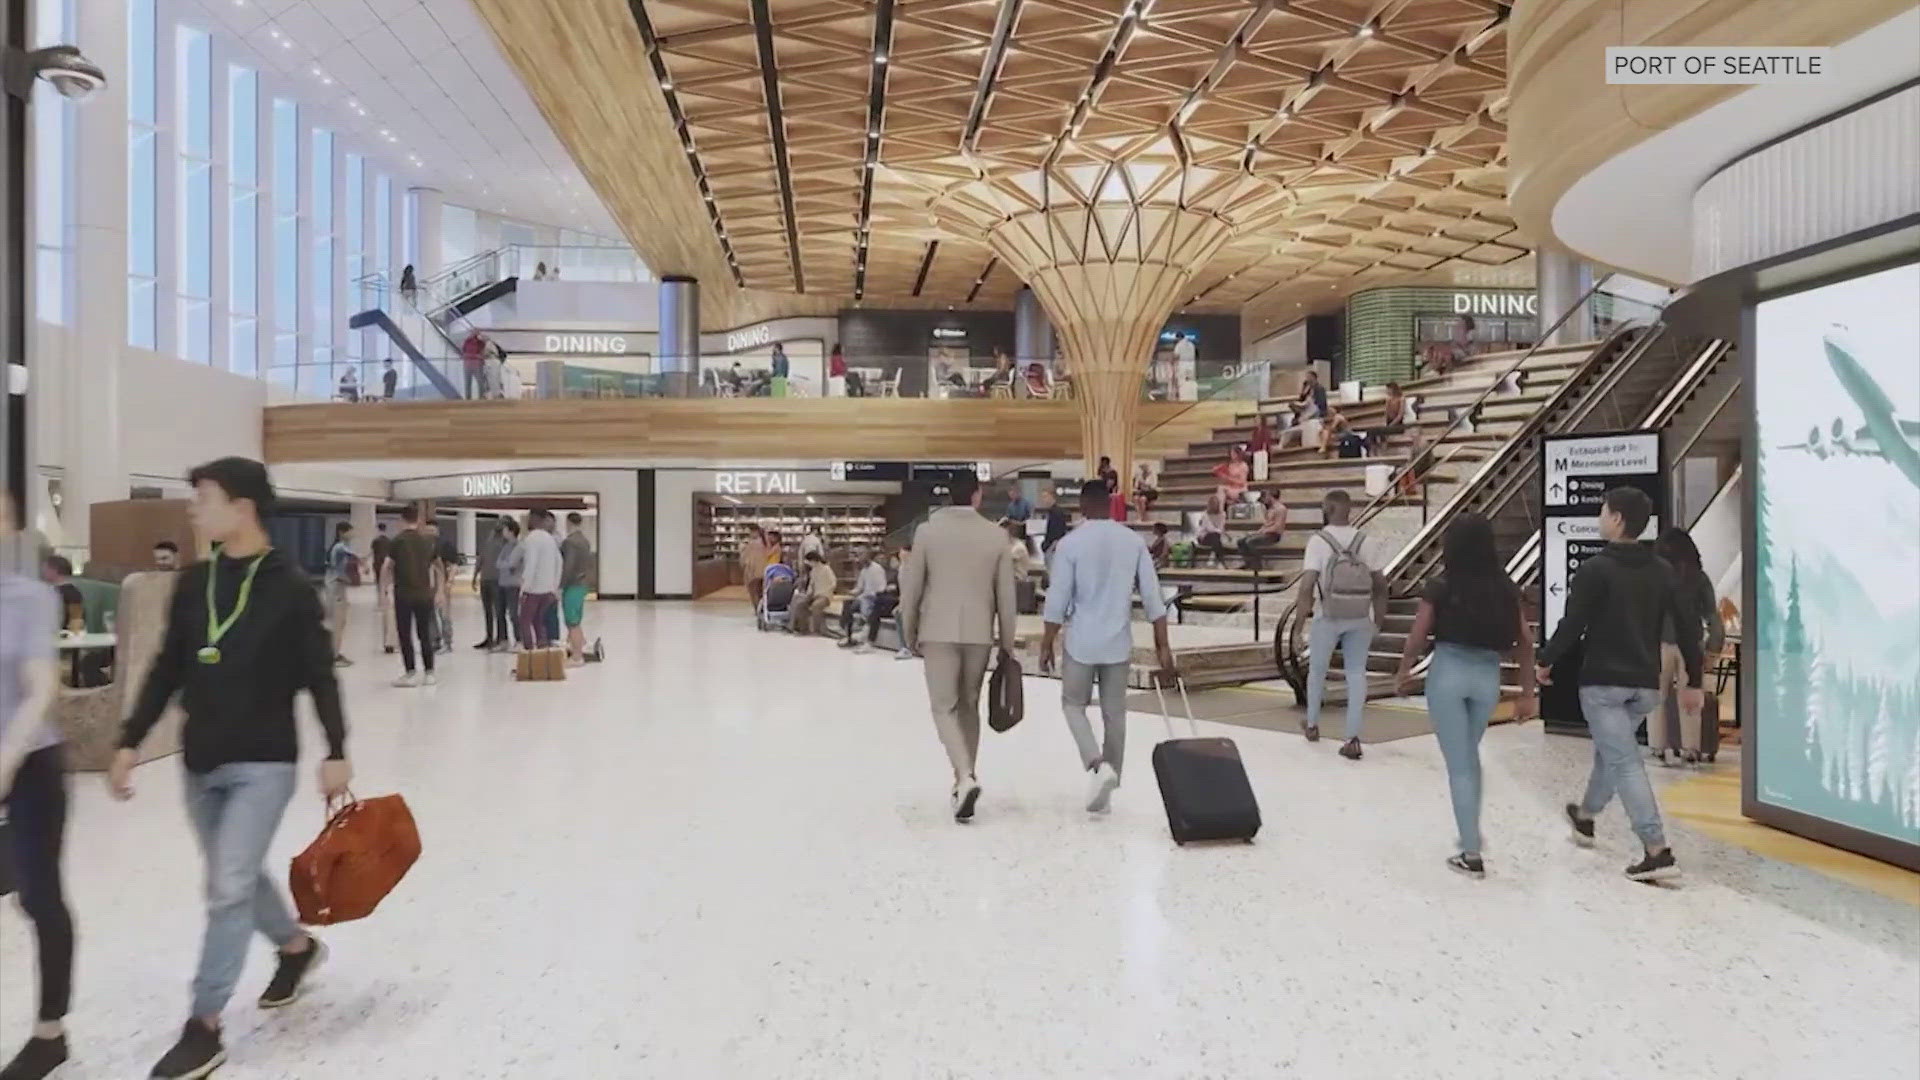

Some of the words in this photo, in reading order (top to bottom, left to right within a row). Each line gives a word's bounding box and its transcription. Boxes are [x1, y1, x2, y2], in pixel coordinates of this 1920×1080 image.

[545, 335, 626, 353] DINING
[728, 326, 769, 351] DINING
[1555, 458, 1568, 471] M
[463, 474, 512, 496] DINING
[715, 473, 805, 494] RETAIL
